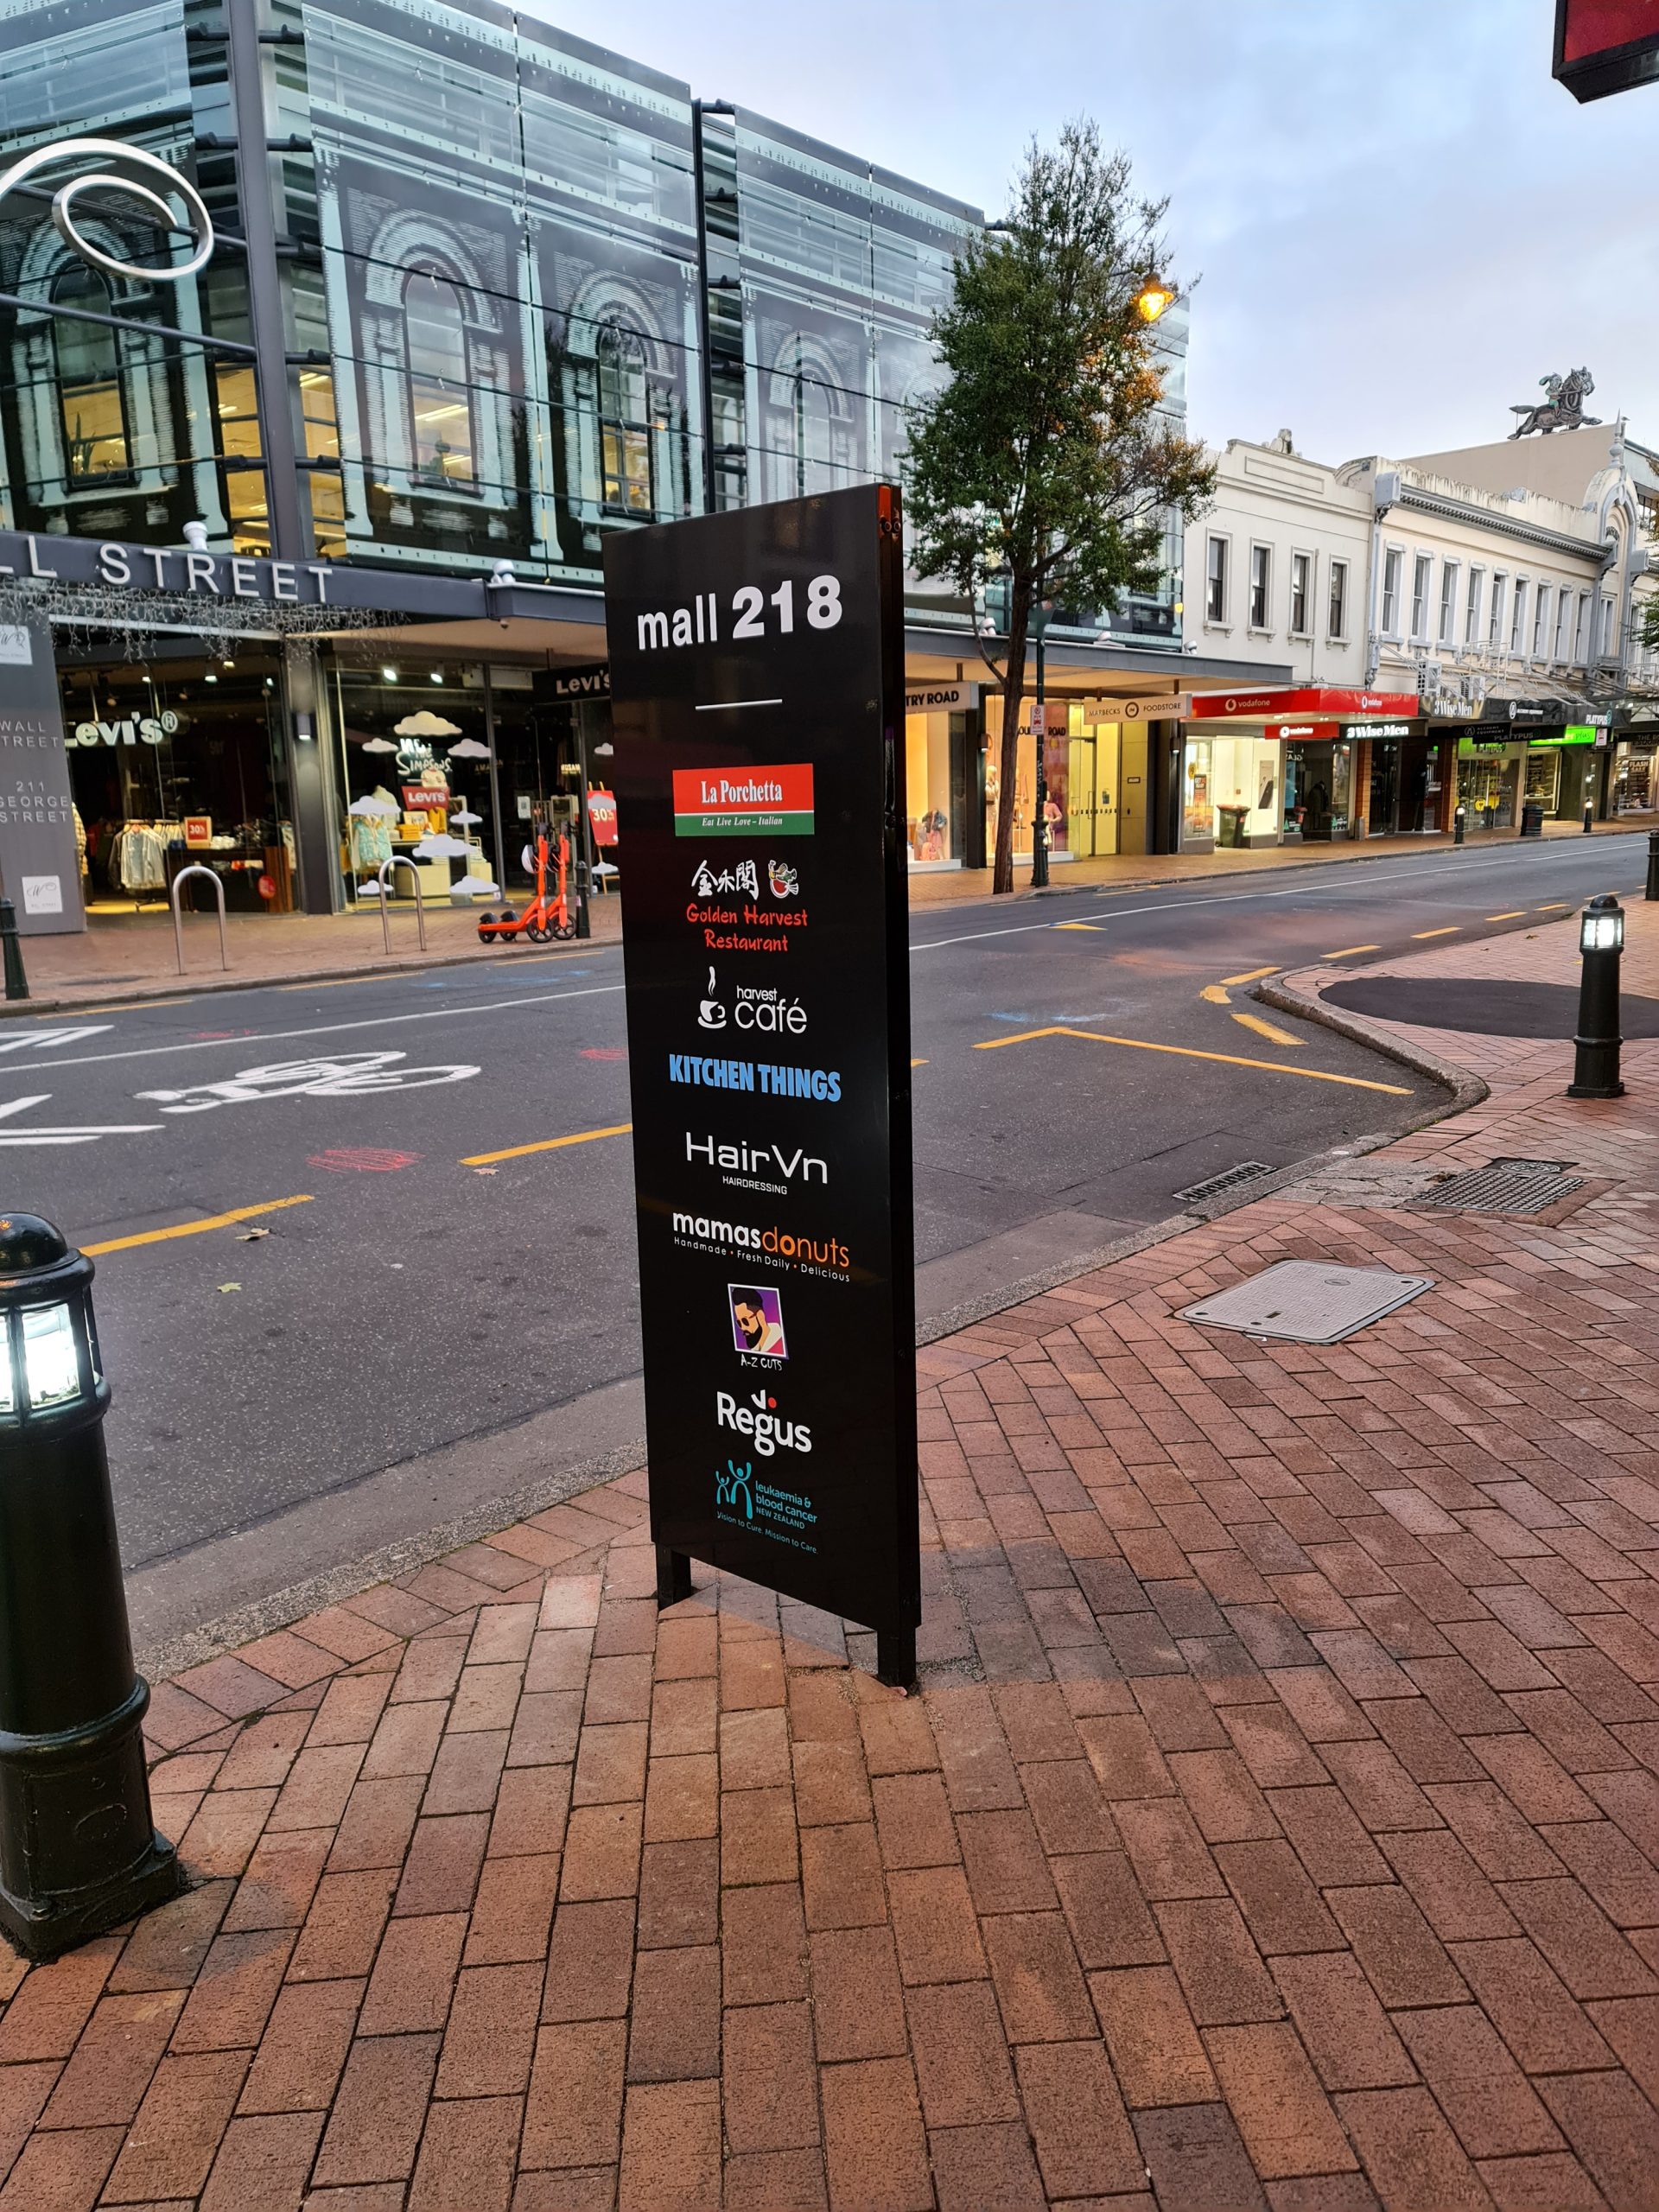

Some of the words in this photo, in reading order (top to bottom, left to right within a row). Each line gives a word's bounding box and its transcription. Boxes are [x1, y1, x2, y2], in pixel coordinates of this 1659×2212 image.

[0, 535, 57, 578] L
[99, 543, 333, 603] STREET
[637, 592, 718, 651] mall
[732, 575, 843, 639] 218
[927, 690, 959, 704] ROAD
[1238, 698, 1271, 709] vodafone
[1089, 709, 1122, 717] MARBECKS
[1143, 702, 1181, 711] FOODSTORE
[0, 721, 46, 732] WALL
[1048, 727, 1066, 736] ROAD
[1356, 726, 1382, 738] Wise
[1383, 724, 1408, 736] Men
[16, 781, 44, 792] 211
[701, 781, 717, 804] La
[720, 779, 783, 804] Porchetta
[702, 817, 714, 826] Eat
[716, 817, 732, 826] Live
[734, 817, 751, 826] Love
[758, 816, 783, 826] Italian
[686, 902, 738, 924] Golden
[743, 904, 808, 926] Harvest
[703, 928, 788, 952] Restaurant
[736, 984, 778, 1001] harvest
[734, 997, 808, 1034] café
[669, 1053, 754, 1092] KITCHEN
[757, 1063, 842, 1103] THINGS
[685, 1131, 828, 1185] HairVn
[722, 1175, 788, 1195] HAIRDRESSING
[674, 1236, 728, 1255] Handmade
[737, 1249, 762, 1264] Fresh
[765, 1255, 791, 1271] Daily
[800, 1263, 850, 1282] Delicious
[741, 1353, 758, 1368] A-Z
[760, 1357, 783, 1371] CUTS
[716, 1390, 812, 1457] Regus
[755, 1480, 803, 1506] leukaemia
[804, 1497, 811, 1509] &
[755, 1493, 783, 1512] blood
[785, 1504, 817, 1524] cancer
[755, 1506, 772, 1518] NEW
[773, 1511, 805, 1530] ZEALAND
[717, 1510, 737, 1523] Vision
[738, 1518, 745, 1528] to
[765, 1529, 791, 1544] Mission
[791, 1538, 799, 1548] to
